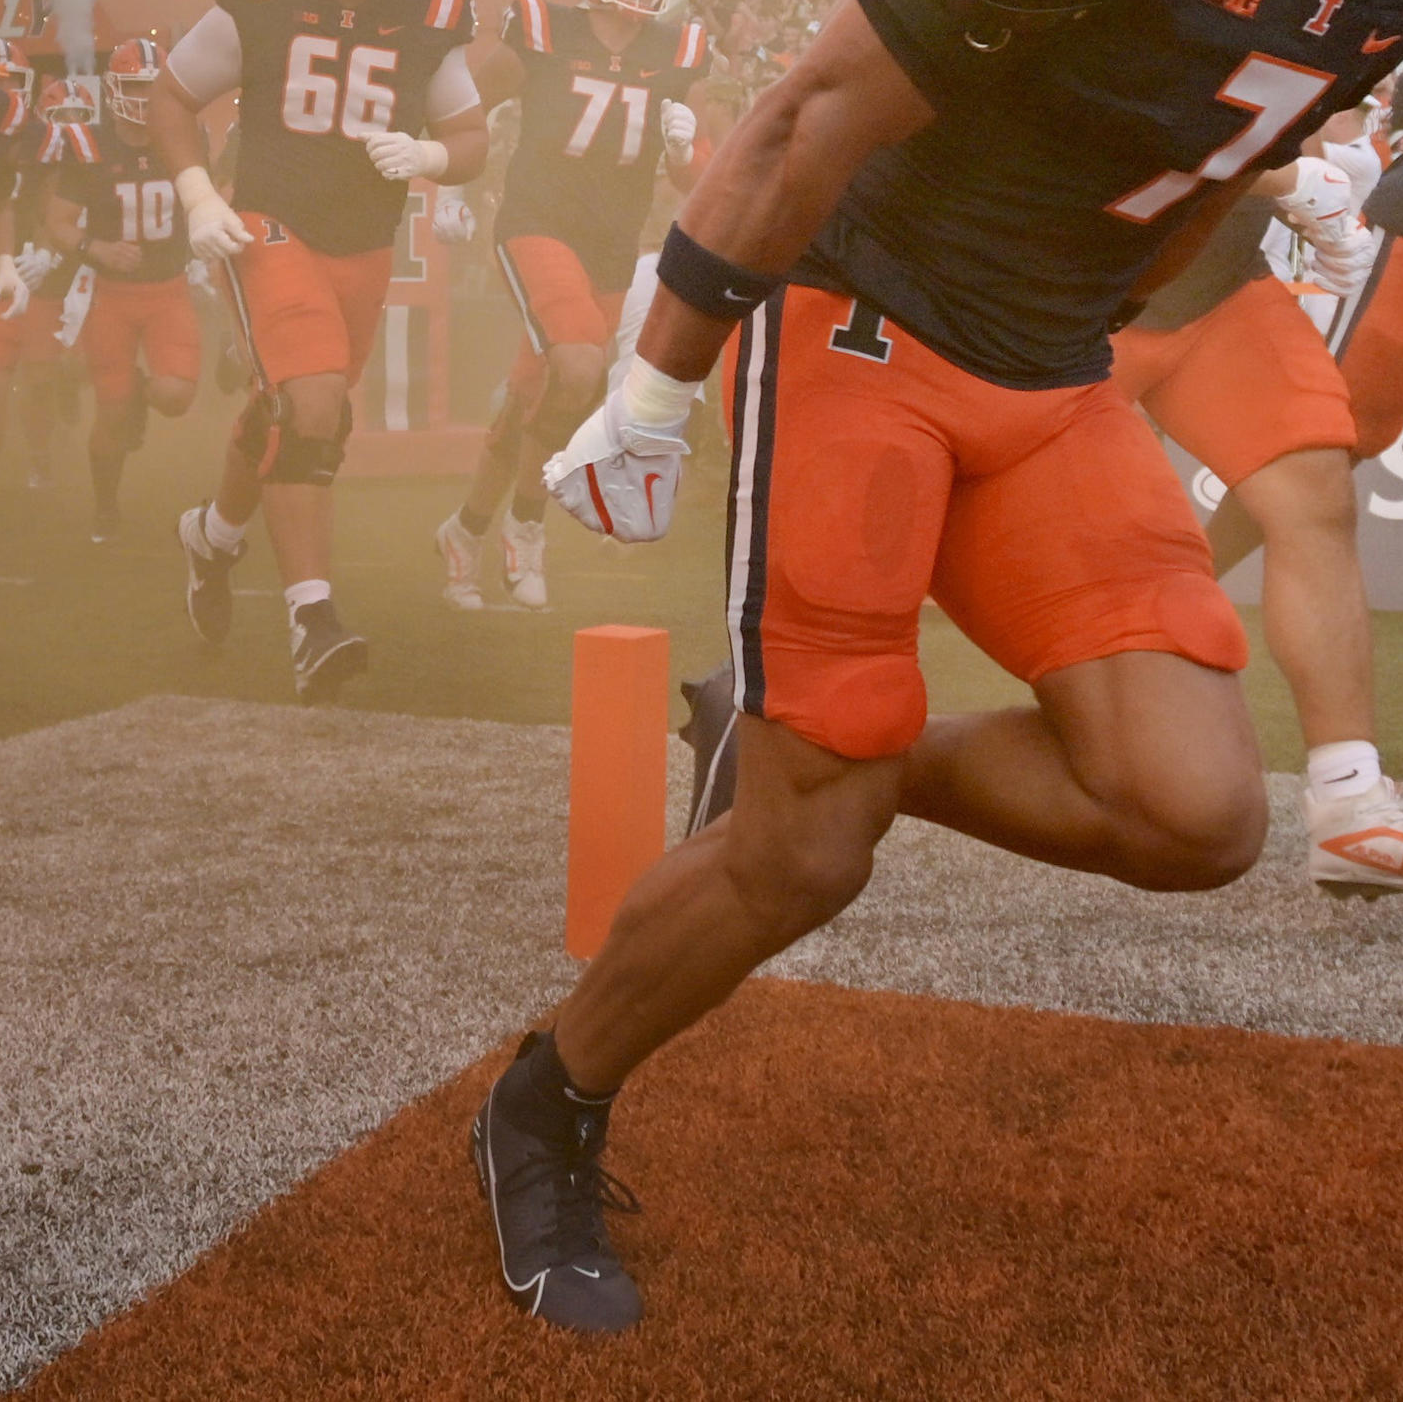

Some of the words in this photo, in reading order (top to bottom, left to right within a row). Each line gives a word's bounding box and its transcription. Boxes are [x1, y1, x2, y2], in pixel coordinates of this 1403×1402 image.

[282, 34, 401, 141] 66
[564, 74, 651, 166] 71
[1103, 51, 1337, 224] 7
[115, 179, 175, 242] 10
